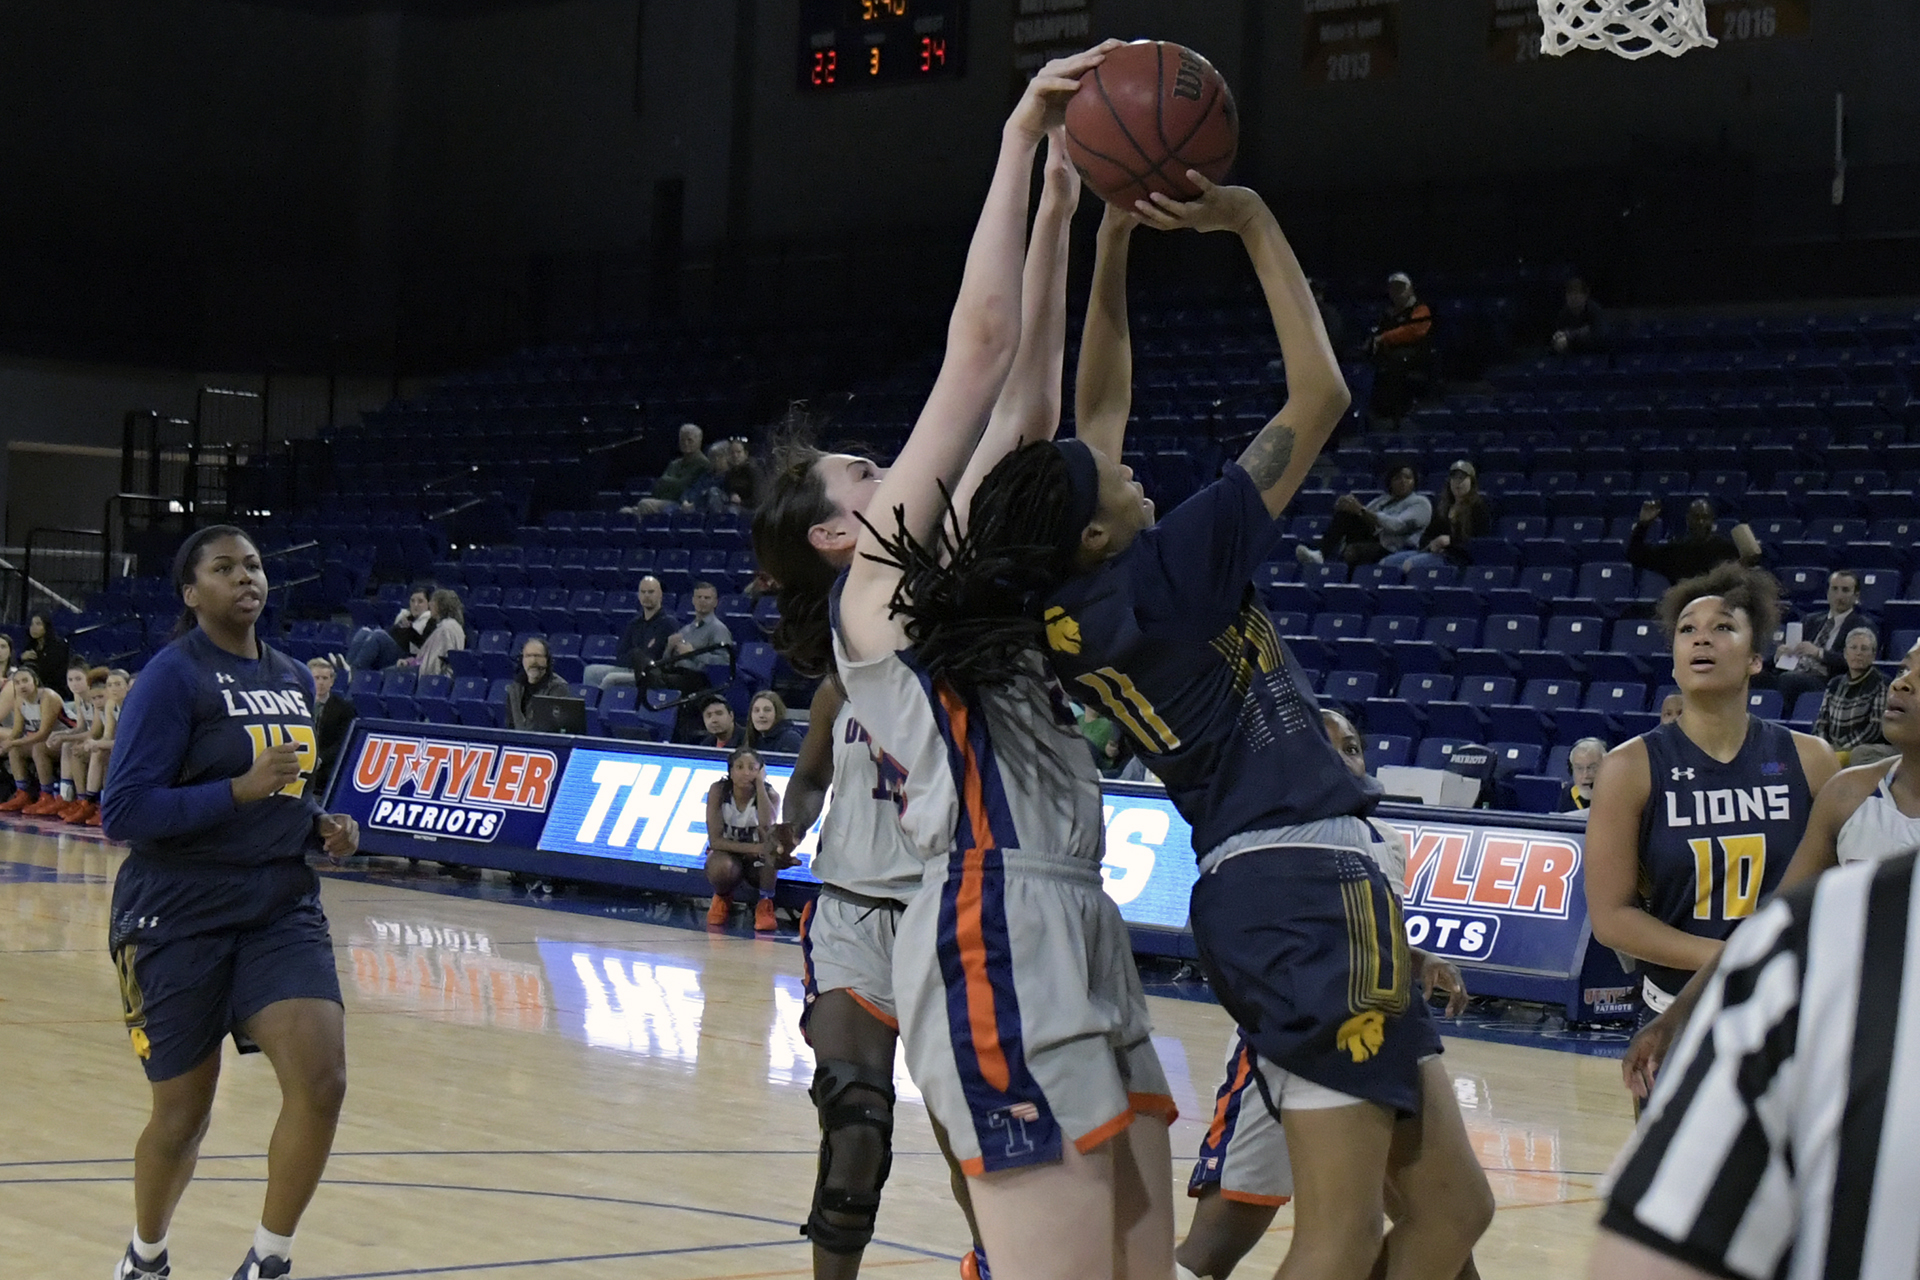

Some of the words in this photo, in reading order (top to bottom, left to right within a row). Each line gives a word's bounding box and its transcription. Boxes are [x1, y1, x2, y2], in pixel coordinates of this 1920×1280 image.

[1723, 7, 1776, 41] 2016
[811, 50, 838, 85] 22
[869, 47, 881, 75] 3
[920, 36, 947, 72] 34
[221, 688, 312, 717] LIONS
[1450, 753, 1487, 765] PATRIOTS
[374, 800, 498, 837] PATRIOTS
[1664, 784, 1790, 827] LIONS
[1402, 825, 1582, 920] YLER
[1687, 832, 1767, 921] 10
[1595, 1003, 1632, 1012] PATRIOTS
